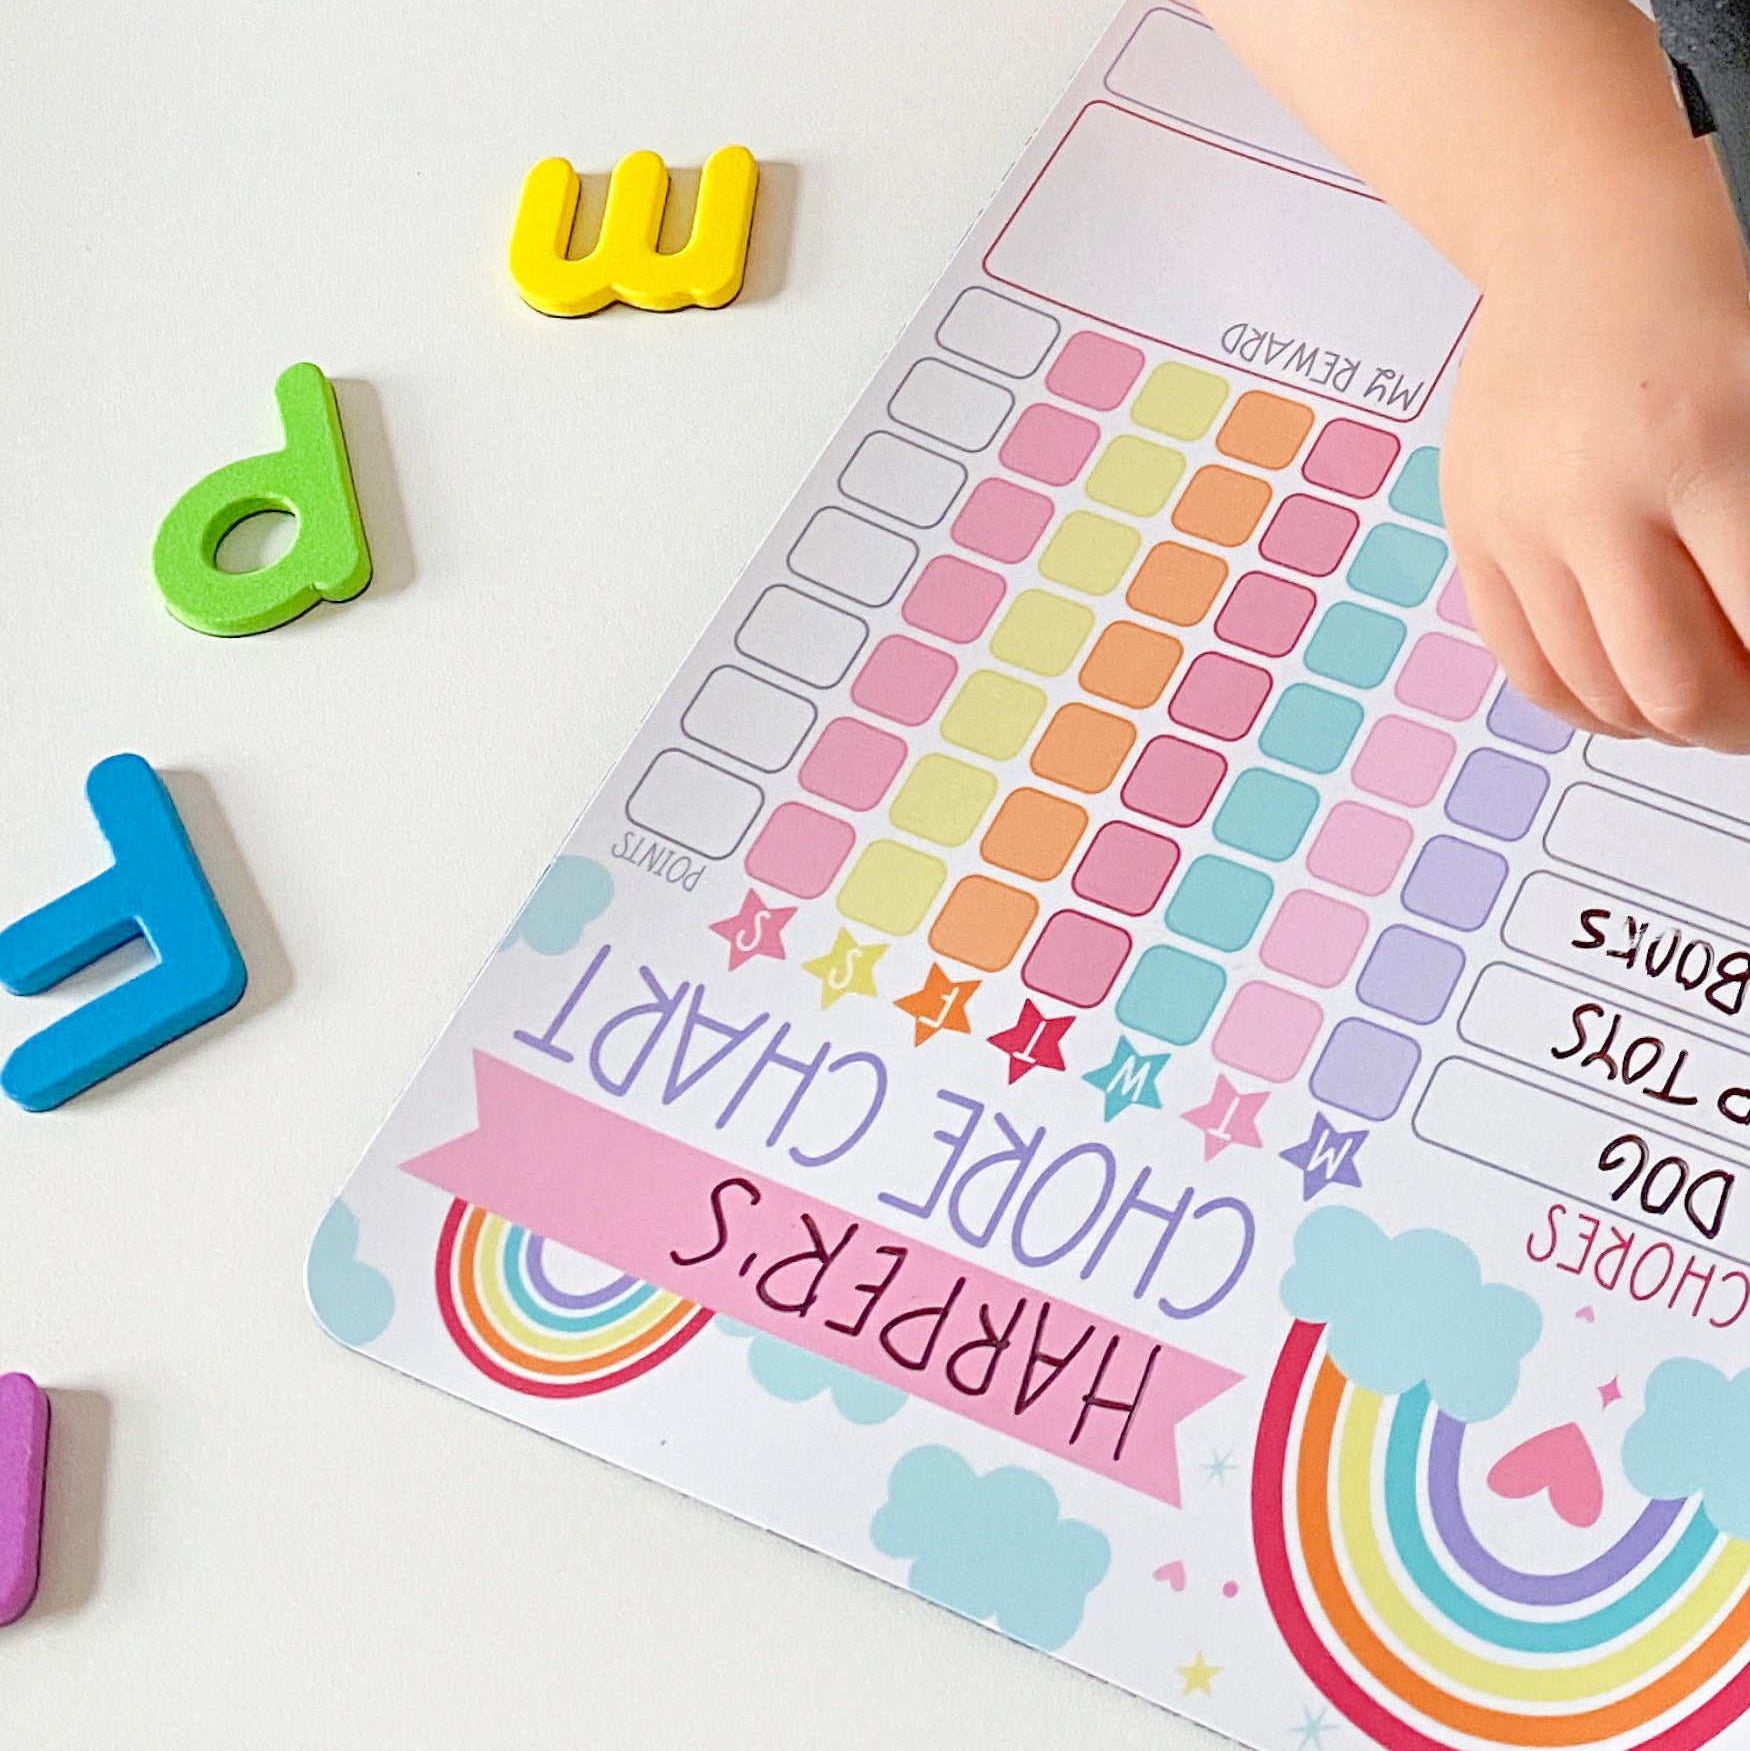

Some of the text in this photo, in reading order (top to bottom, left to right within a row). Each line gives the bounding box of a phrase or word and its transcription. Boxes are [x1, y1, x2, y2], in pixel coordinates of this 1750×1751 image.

[1221, 323, 1361, 393] REWARD
[612, 830, 704, 892] POINTS
[737, 911, 1352, 1179] M T W T F S S
[1551, 1003, 1699, 1106] TOYS
[513, 944, 1255, 1320] CHORE CHART
[1597, 1134, 1736, 1240] DOG
[670, 1178, 1163, 1461] HARPER'S
[1527, 1204, 1750, 1328] CHORES
